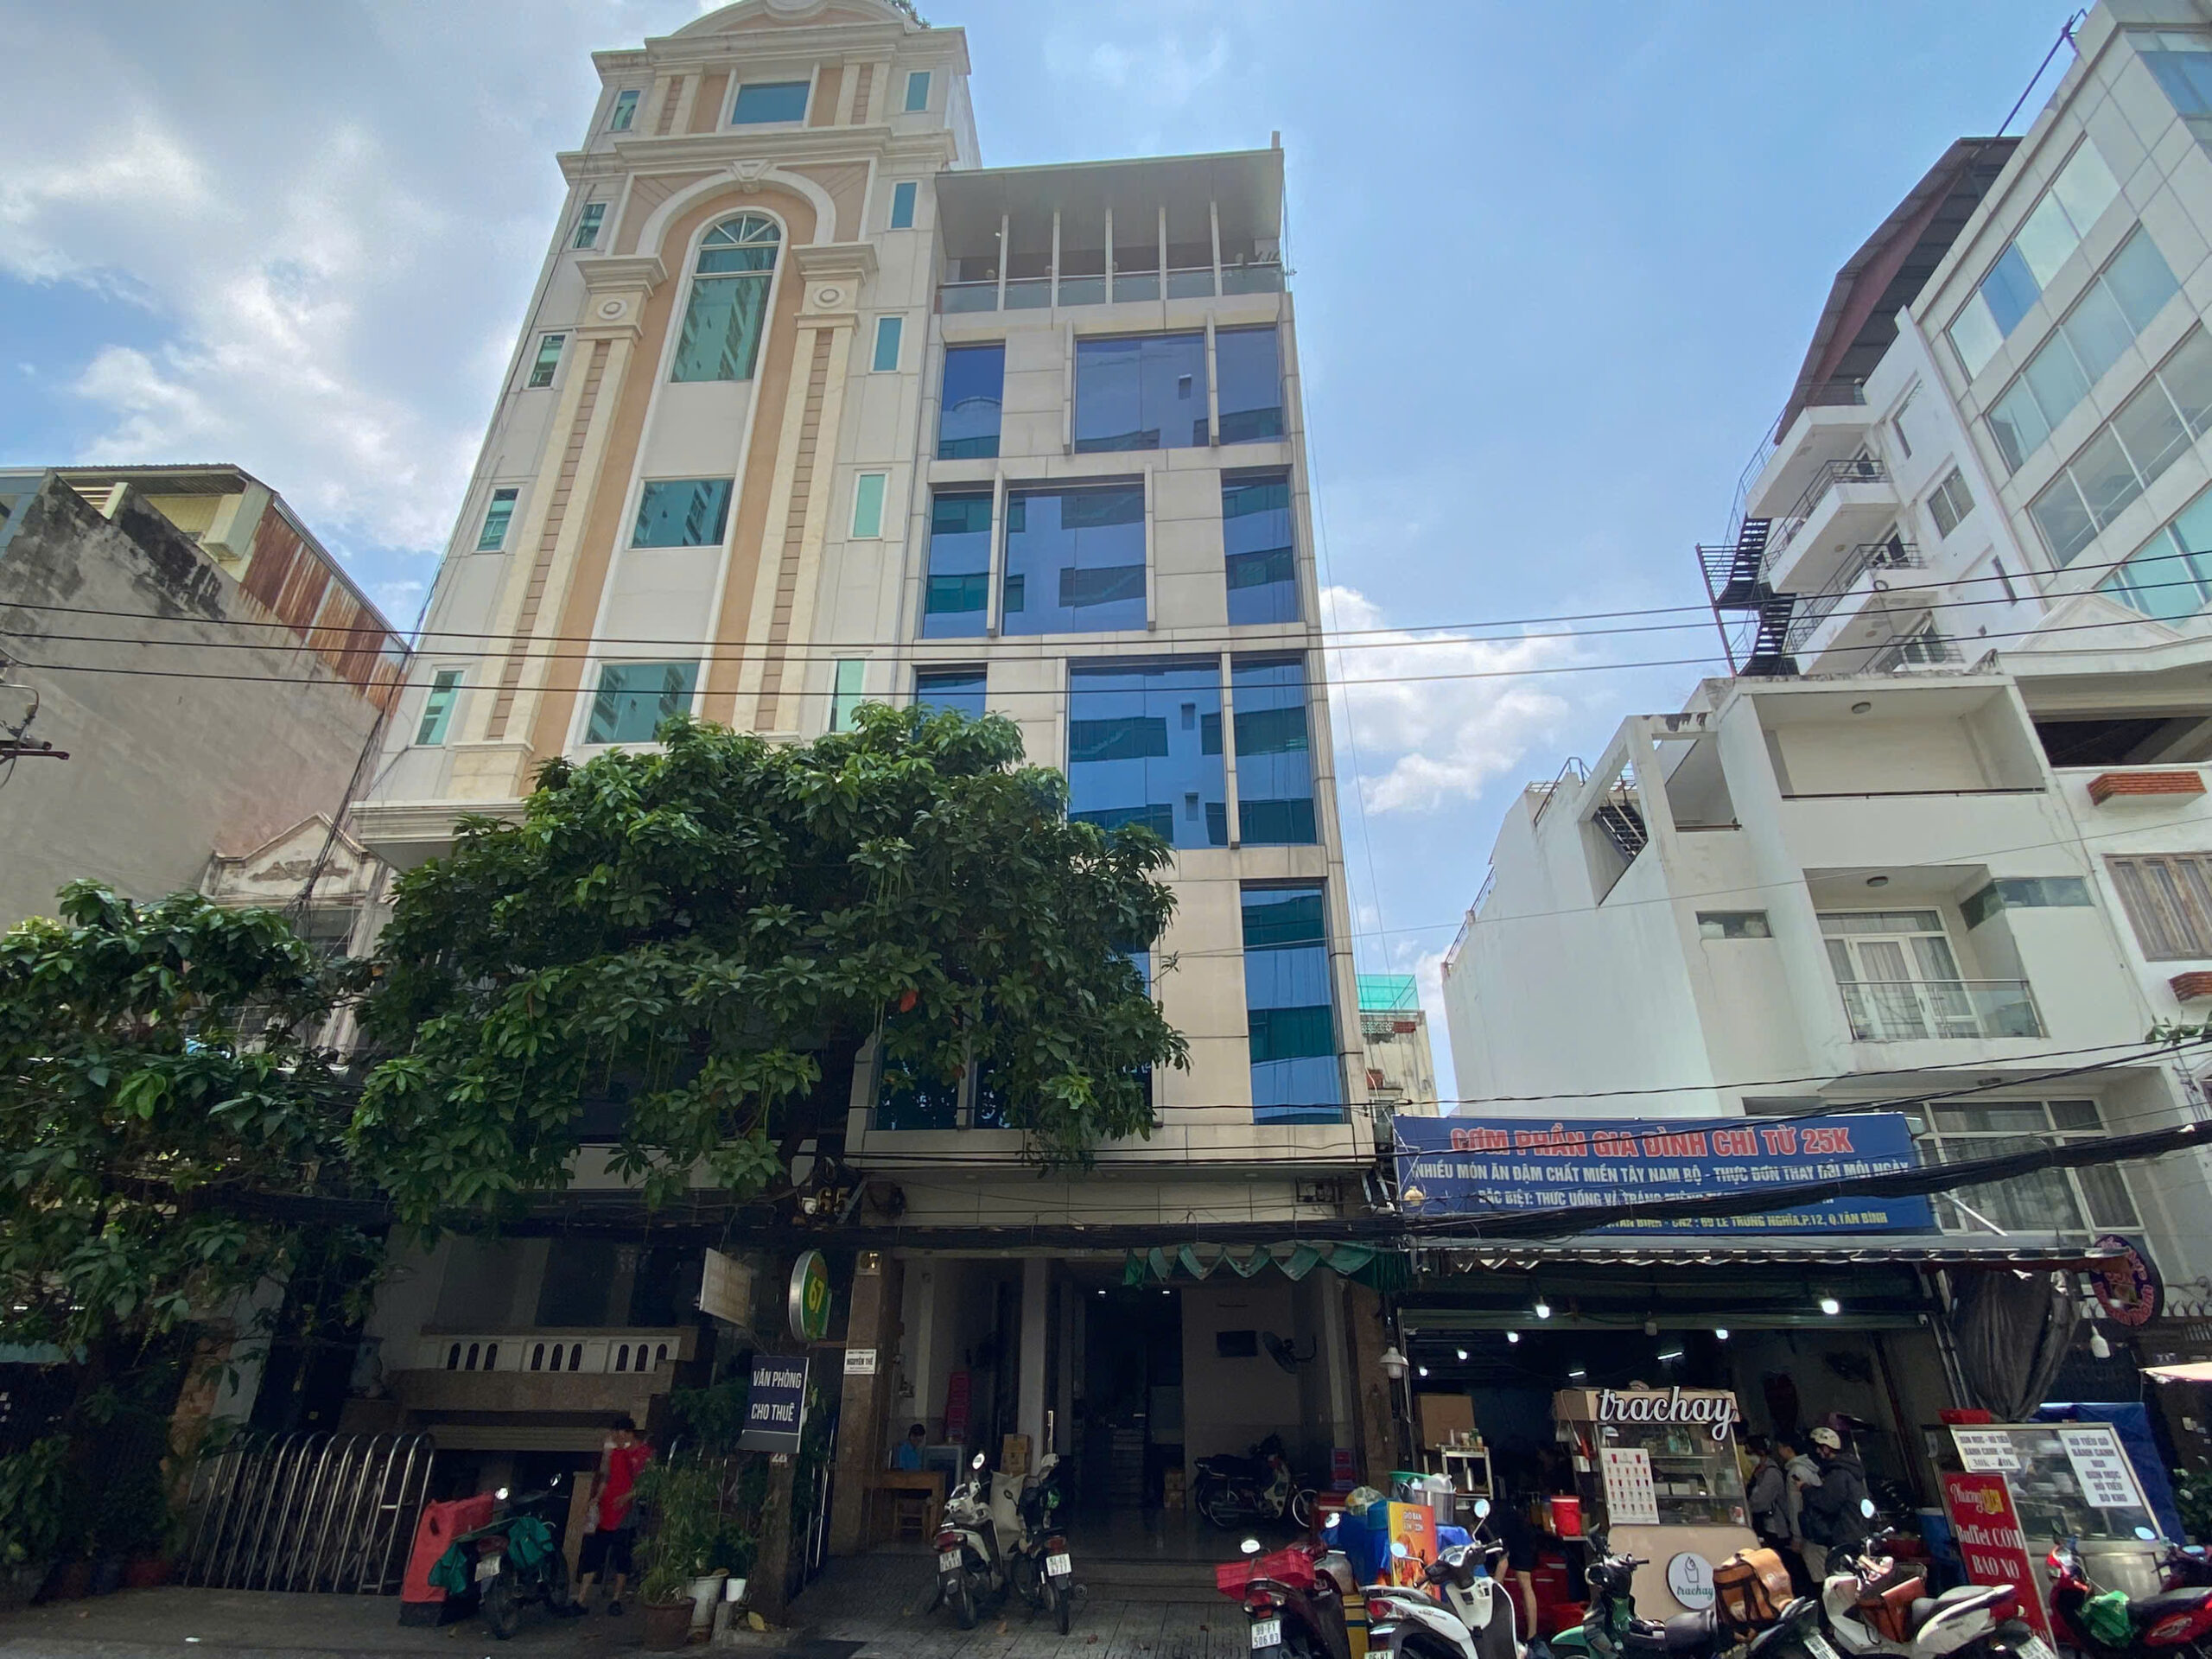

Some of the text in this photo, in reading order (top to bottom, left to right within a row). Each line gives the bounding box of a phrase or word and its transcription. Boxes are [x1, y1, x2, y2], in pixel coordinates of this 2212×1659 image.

[1451, 1127, 1510, 1155] CƠM
[1515, 1122, 1587, 1156] PHẦN
[1592, 1130, 1639, 1157] GIA
[1642, 1126, 1708, 1157] ĐÌNH
[1760, 1124, 1796, 1155] TỪ
[1801, 1127, 1854, 1154] 25K
[1457, 1162, 1488, 1179] MÓN
[1491, 1163, 1510, 1180] ĂN
[1512, 1163, 1543, 1184] ĐẬM
[1547, 1162, 1580, 1181] CHẤT
[1620, 1165, 1644, 1182] TÂY
[1648, 1167, 1681, 1182] NAM
[1683, 1165, 1701, 1185] BỘ
[1713, 1166, 1749, 1185] THỰC
[1751, 1166, 1780, 1181] ĐƠN
[1782, 1166, 1815, 1180] THAY
[809, 1277, 824, 1313] 67
[753, 1368, 802, 1389] VĂN PHÒNG
[751, 1402, 795, 1422] CHO THUÊ
[1599, 1386, 1737, 1440] trachay
[1676, 1585, 1713, 1600] trachay
